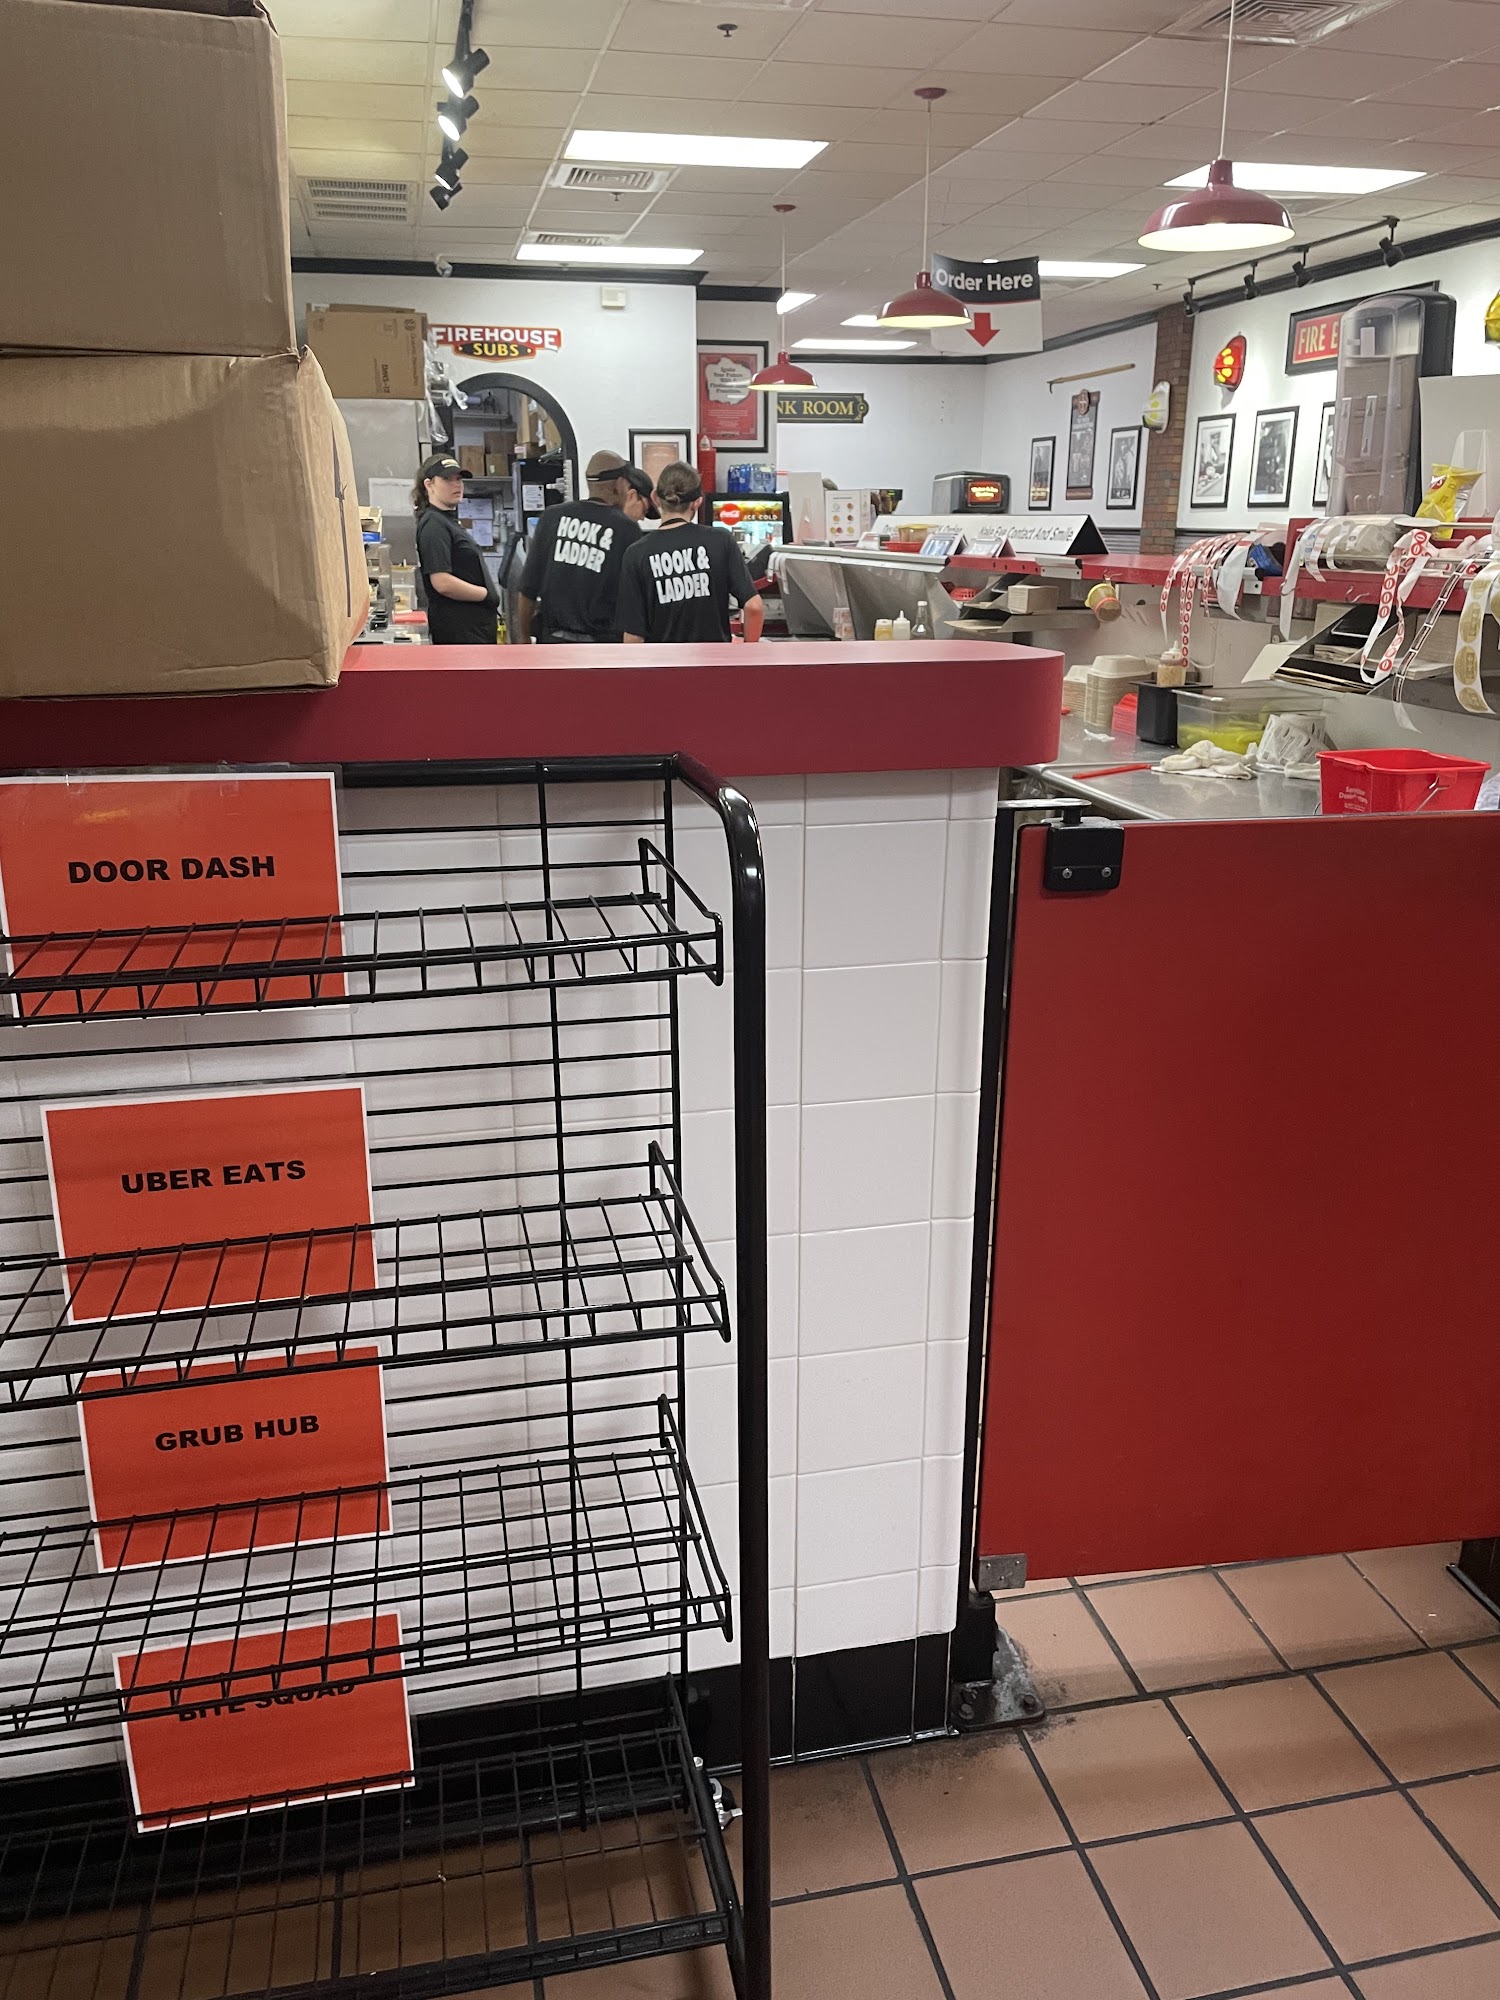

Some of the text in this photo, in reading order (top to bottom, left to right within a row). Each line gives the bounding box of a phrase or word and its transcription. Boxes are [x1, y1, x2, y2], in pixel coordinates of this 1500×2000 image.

[936, 268, 1034, 292] Order Here
[431, 326, 558, 351] FIREHOUSE
[472, 343, 519, 357] SUBS
[1298, 324, 1326, 354] FIRE
[802, 400, 854, 416] ROOM
[557, 516, 614, 551] HOOK &
[1007, 526, 1035, 540] Contact
[1034, 526, 1053, 541] And
[554, 539, 606, 573] LADDER
[648, 546, 710, 578] HOOK &
[656, 573, 710, 604] LADDER
[68, 855, 275, 883] DOOR DASH
[121, 1159, 306, 1194] UBER EATS
[155, 1415, 320, 1451] GRUB HUB
